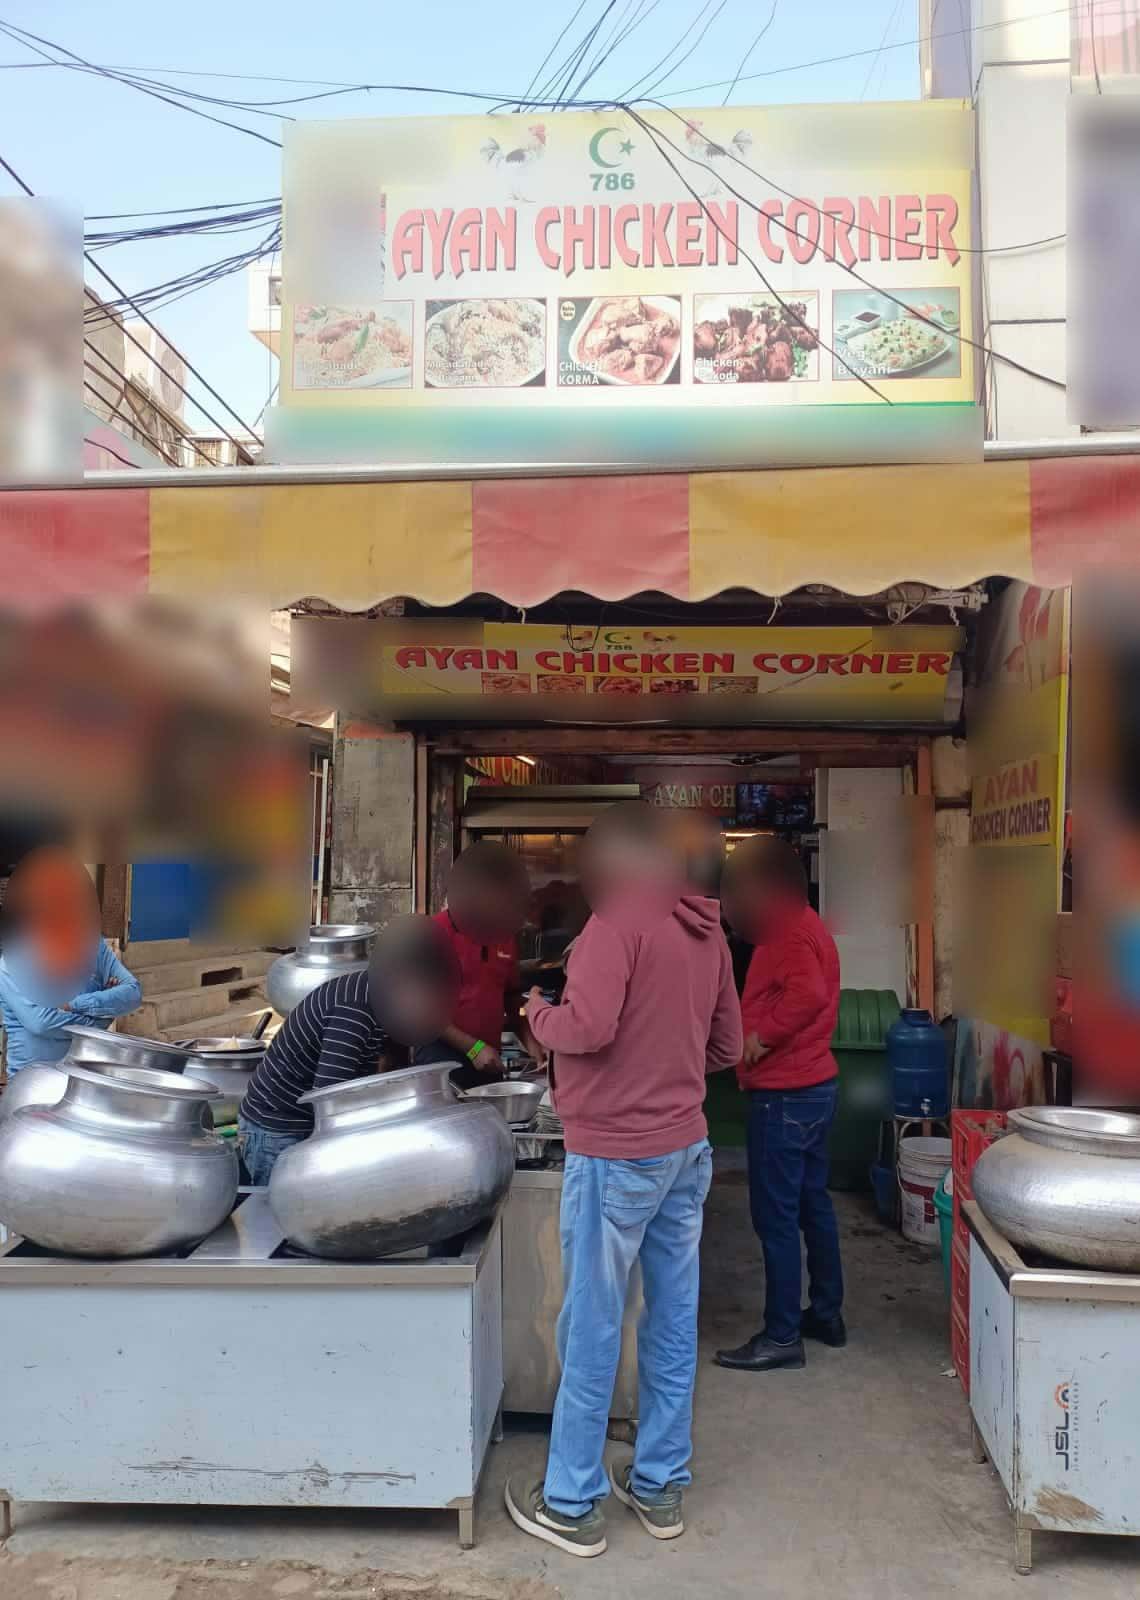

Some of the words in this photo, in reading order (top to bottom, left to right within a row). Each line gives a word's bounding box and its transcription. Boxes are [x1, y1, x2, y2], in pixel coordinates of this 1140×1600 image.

[589, 173, 636, 191] 786
[391, 207, 517, 281] AYAN
[534, 200, 740, 278] CHICKEN
[757, 194, 961, 271] CORNER
[559, 374, 600, 385] KORMA
[395, 647, 518, 671] AYAN
[535, 650, 735, 674] CHICKEN
[752, 652, 951, 676] CORNER
[654, 784, 704, 809] AYAN
[984, 760, 1039, 808] AYAN
[972, 807, 1007, 841] CHICKEN
[1008, 797, 1051, 838] CORNER
